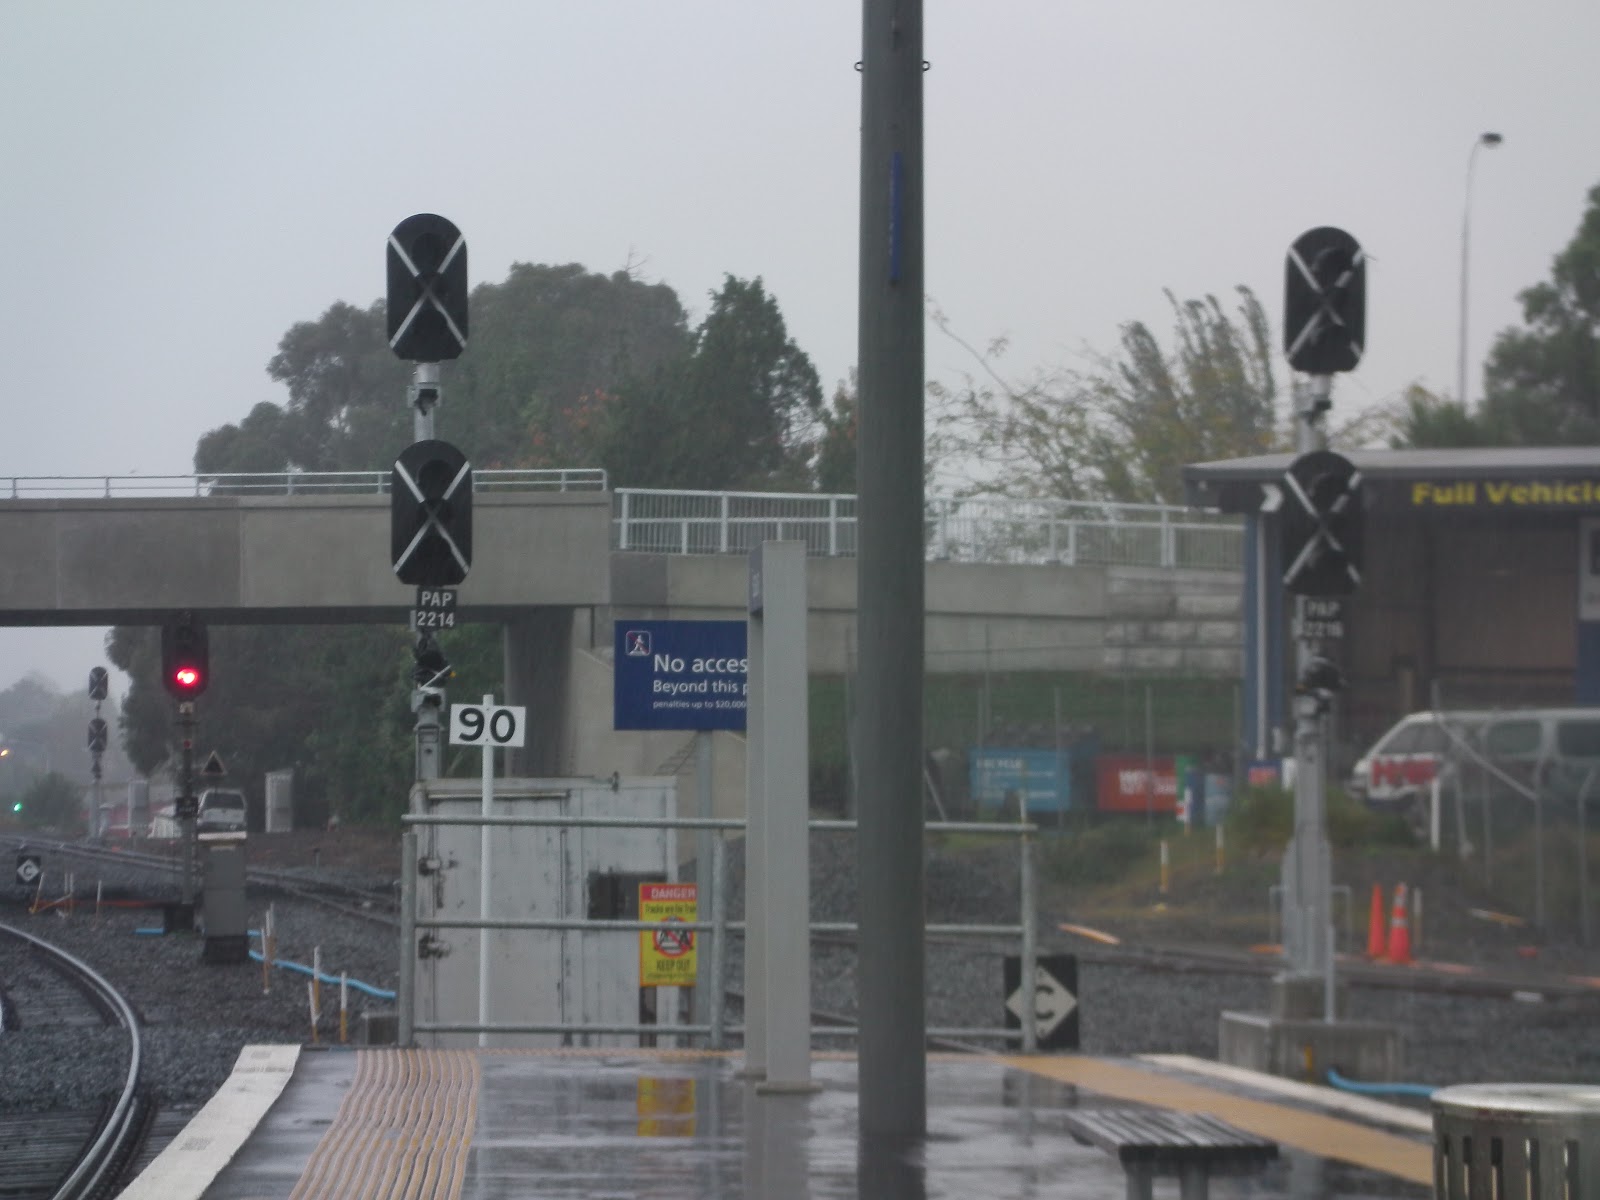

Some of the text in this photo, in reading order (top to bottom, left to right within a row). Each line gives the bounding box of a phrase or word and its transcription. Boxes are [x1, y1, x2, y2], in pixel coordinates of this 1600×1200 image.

[1412, 481, 1476, 505] Full
[421, 591, 452, 607] PAP
[417, 611, 455, 627] 2214
[653, 654, 748, 673] No acces
[653, 680, 707, 695] Beyond
[712, 680, 738, 693] this
[653, 700, 690, 709] penalties
[458, 707, 516, 743] 90
[23, 864, 33, 877] C
[651, 887, 696, 899] DANGER
